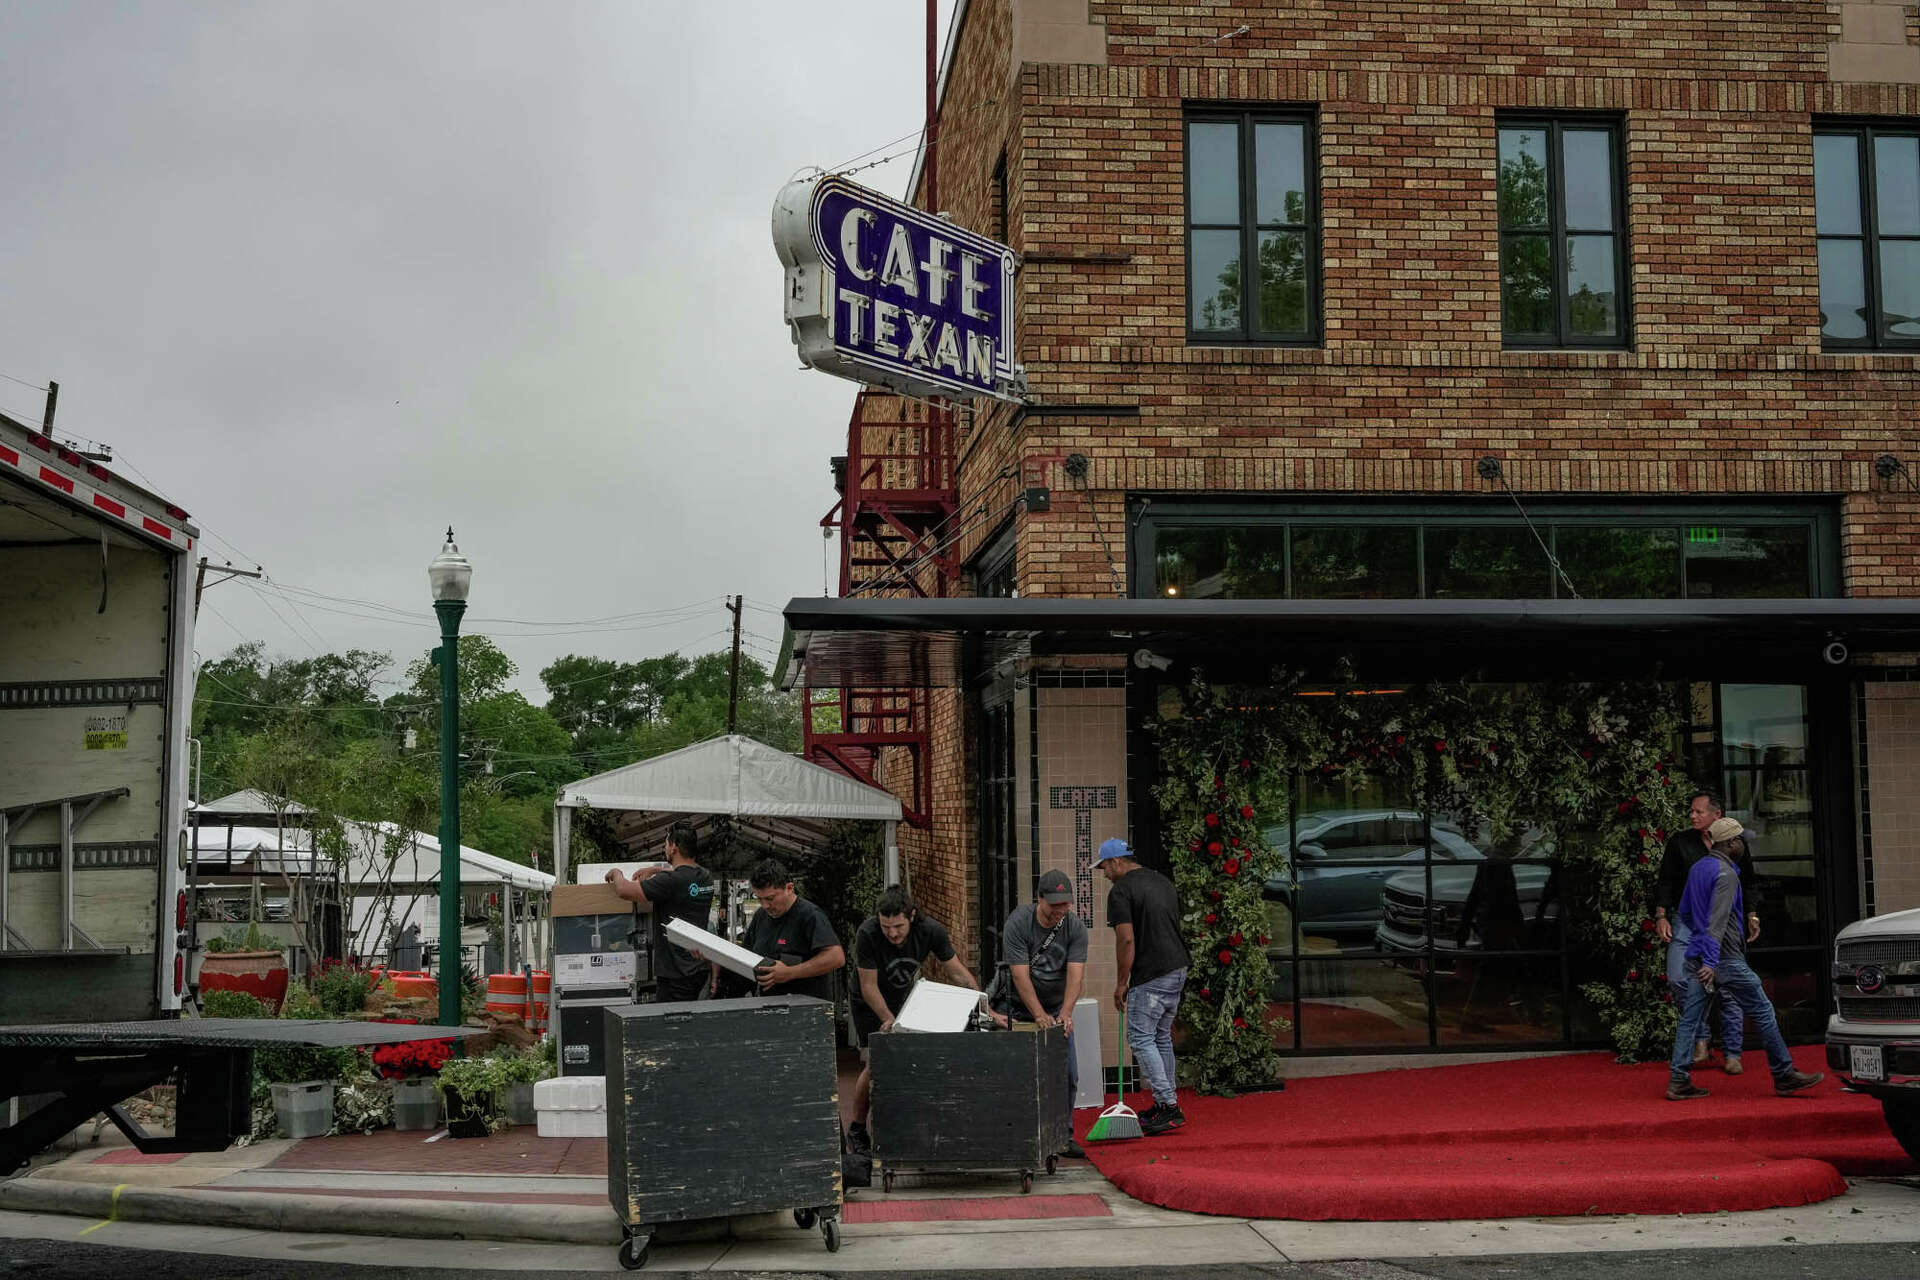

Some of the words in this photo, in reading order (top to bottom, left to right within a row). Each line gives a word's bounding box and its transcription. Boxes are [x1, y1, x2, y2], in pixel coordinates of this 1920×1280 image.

[841, 207, 996, 321] CAFE
[840, 288, 996, 385] TEXAN
[1060, 790, 1107, 806] CAFE
[1079, 811, 1091, 920] TEXAN
[1042, 931, 1056, 949] NEW
